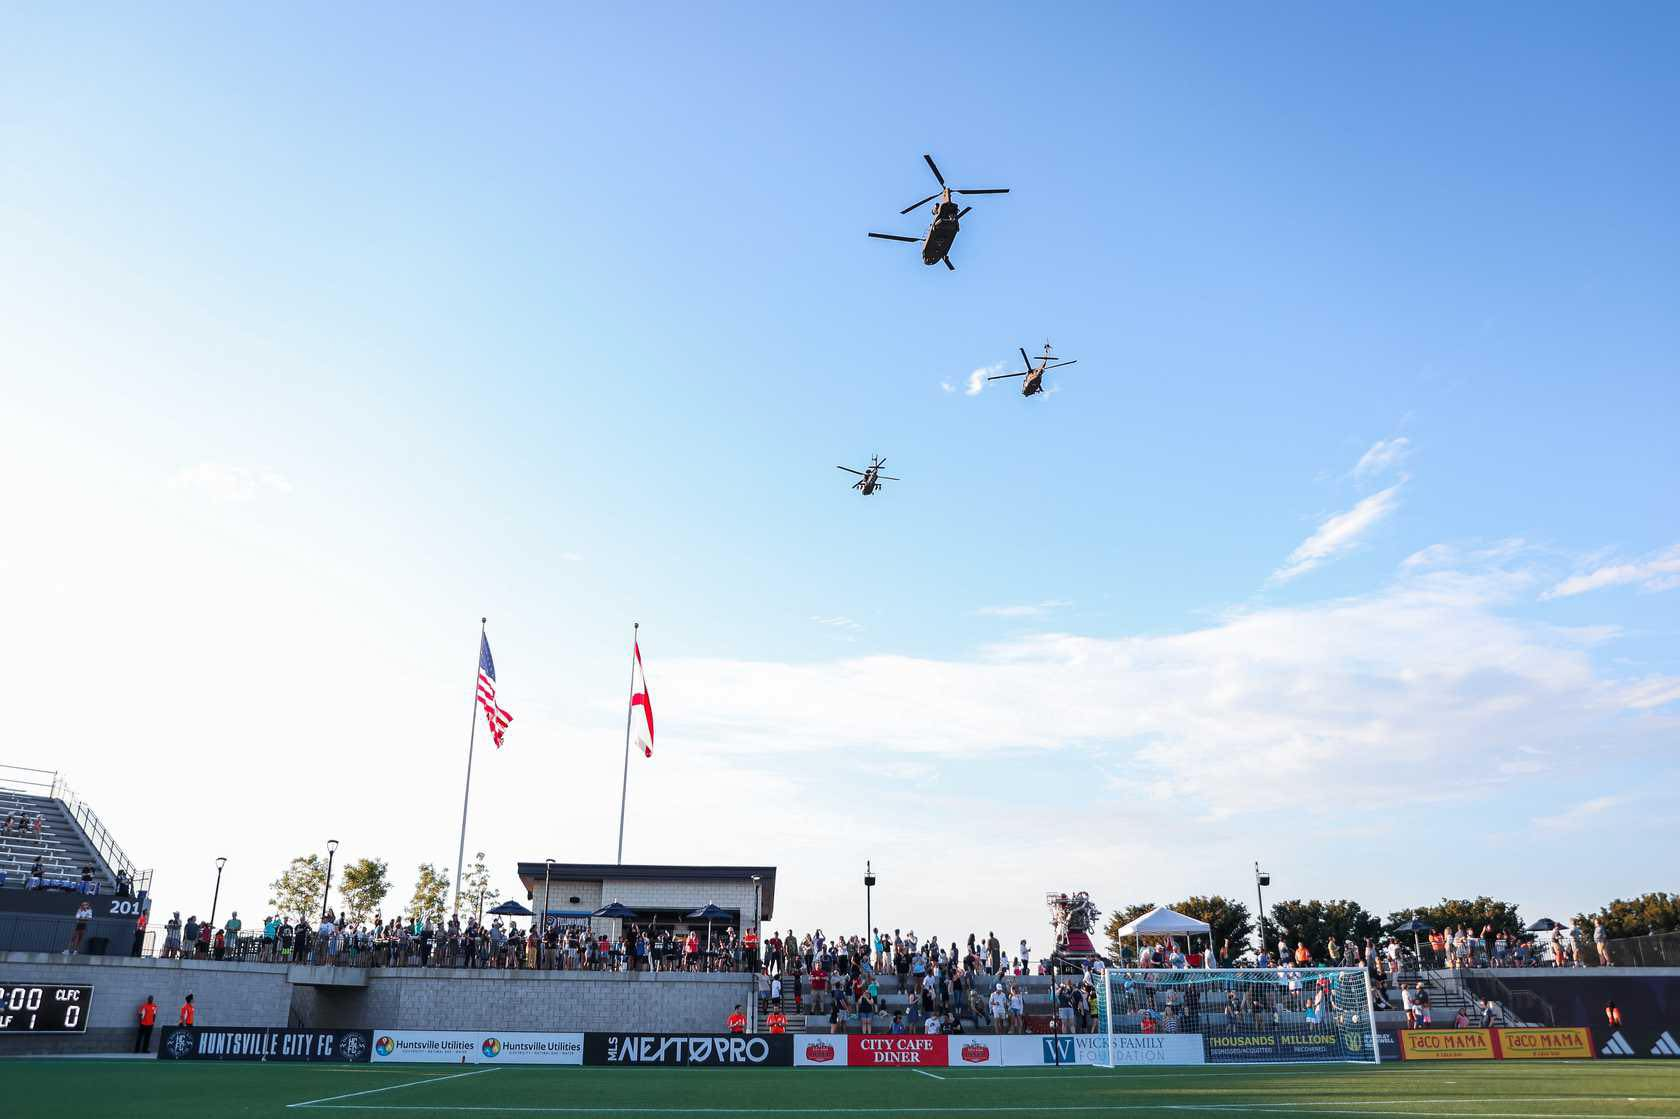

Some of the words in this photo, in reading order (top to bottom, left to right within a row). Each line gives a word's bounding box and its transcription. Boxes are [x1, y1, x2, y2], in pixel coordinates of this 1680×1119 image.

[110, 900, 140, 914] 201
[55, 989, 80, 1001] CLFC
[29, 1014, 37, 1030] 1
[64, 1005, 80, 1027] 0
[199, 1032, 278, 1055] HUNTSVILLE
[282, 1034, 313, 1056] CITY
[317, 1034, 334, 1056] FC
[396, 1040, 440, 1050] Huntsville
[441, 1040, 475, 1050] Utilities
[502, 1041, 546, 1051] Huntsville
[547, 1041, 581, 1051] Utilities
[860, 1039, 894, 1050] CITY
[896, 1039, 934, 1051] CAFE
[1119, 1037, 1165, 1049] FAMILY
[1209, 1035, 1275, 1048] THOUSANDS
[1281, 1034, 1336, 1045] MILLIONS
[1444, 1035, 1486, 1049] MAMA
[1541, 1033, 1584, 1048] MAMA
[607, 1036, 618, 1061] MLS
[873, 1051, 921, 1063] DINER
